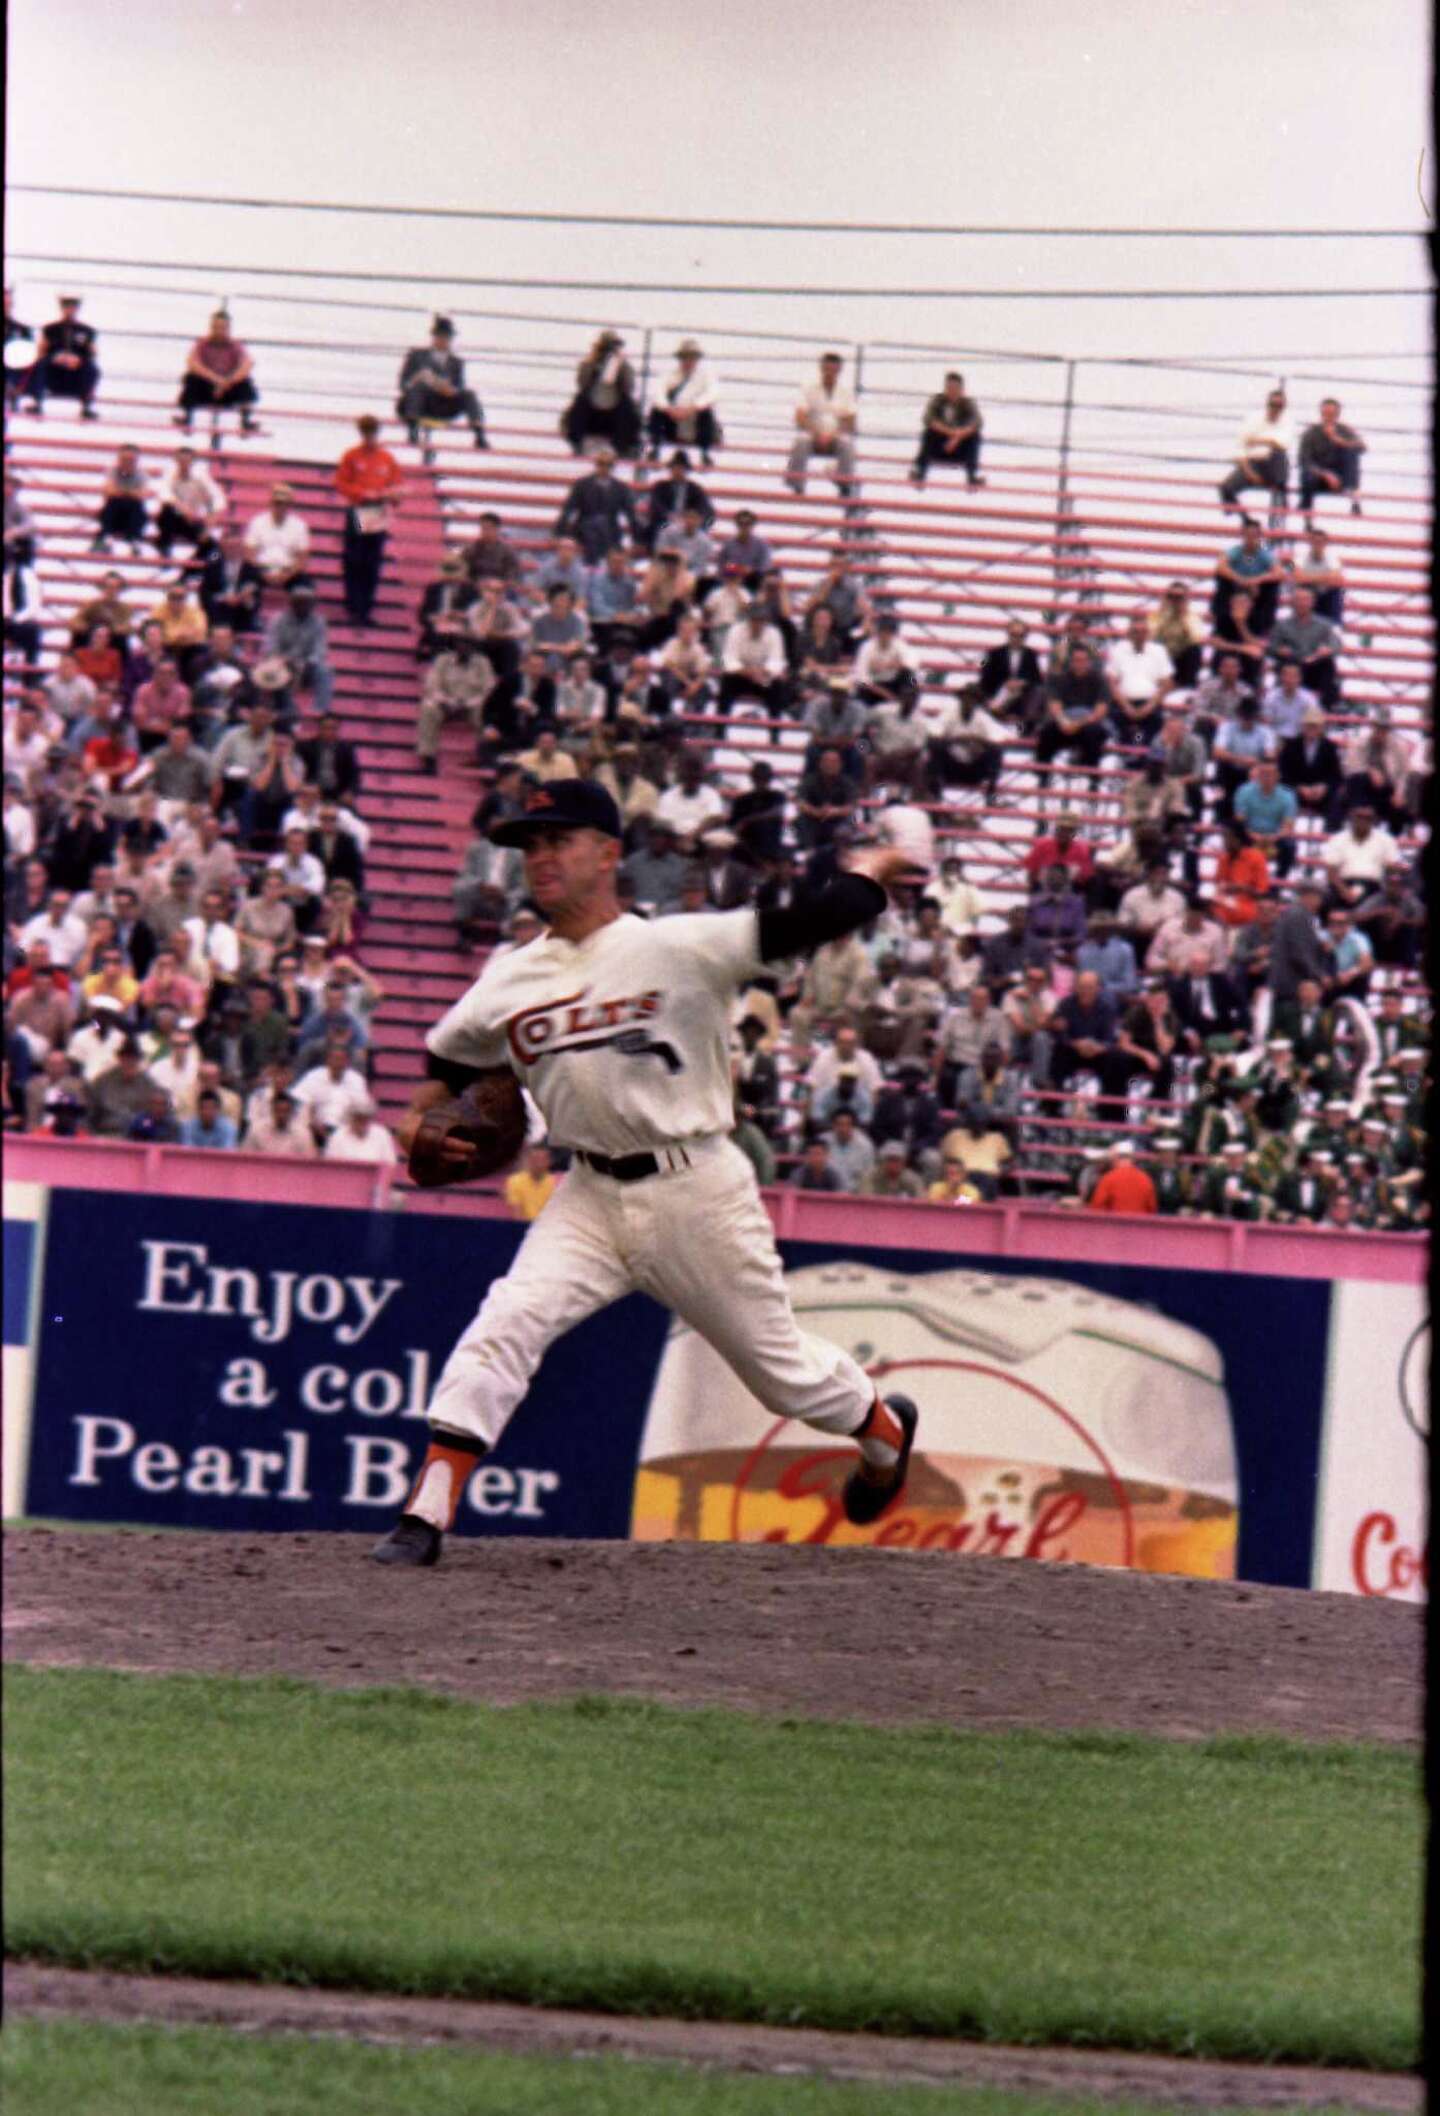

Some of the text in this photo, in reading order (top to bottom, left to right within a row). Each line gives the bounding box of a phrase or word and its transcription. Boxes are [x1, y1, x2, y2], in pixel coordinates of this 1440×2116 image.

[507, 990, 662, 1065] COLTS
[137, 1240, 401, 1344] Enjoy
[219, 1349, 431, 1419] a col
[69, 1415, 560, 1517] Pearl Ber
